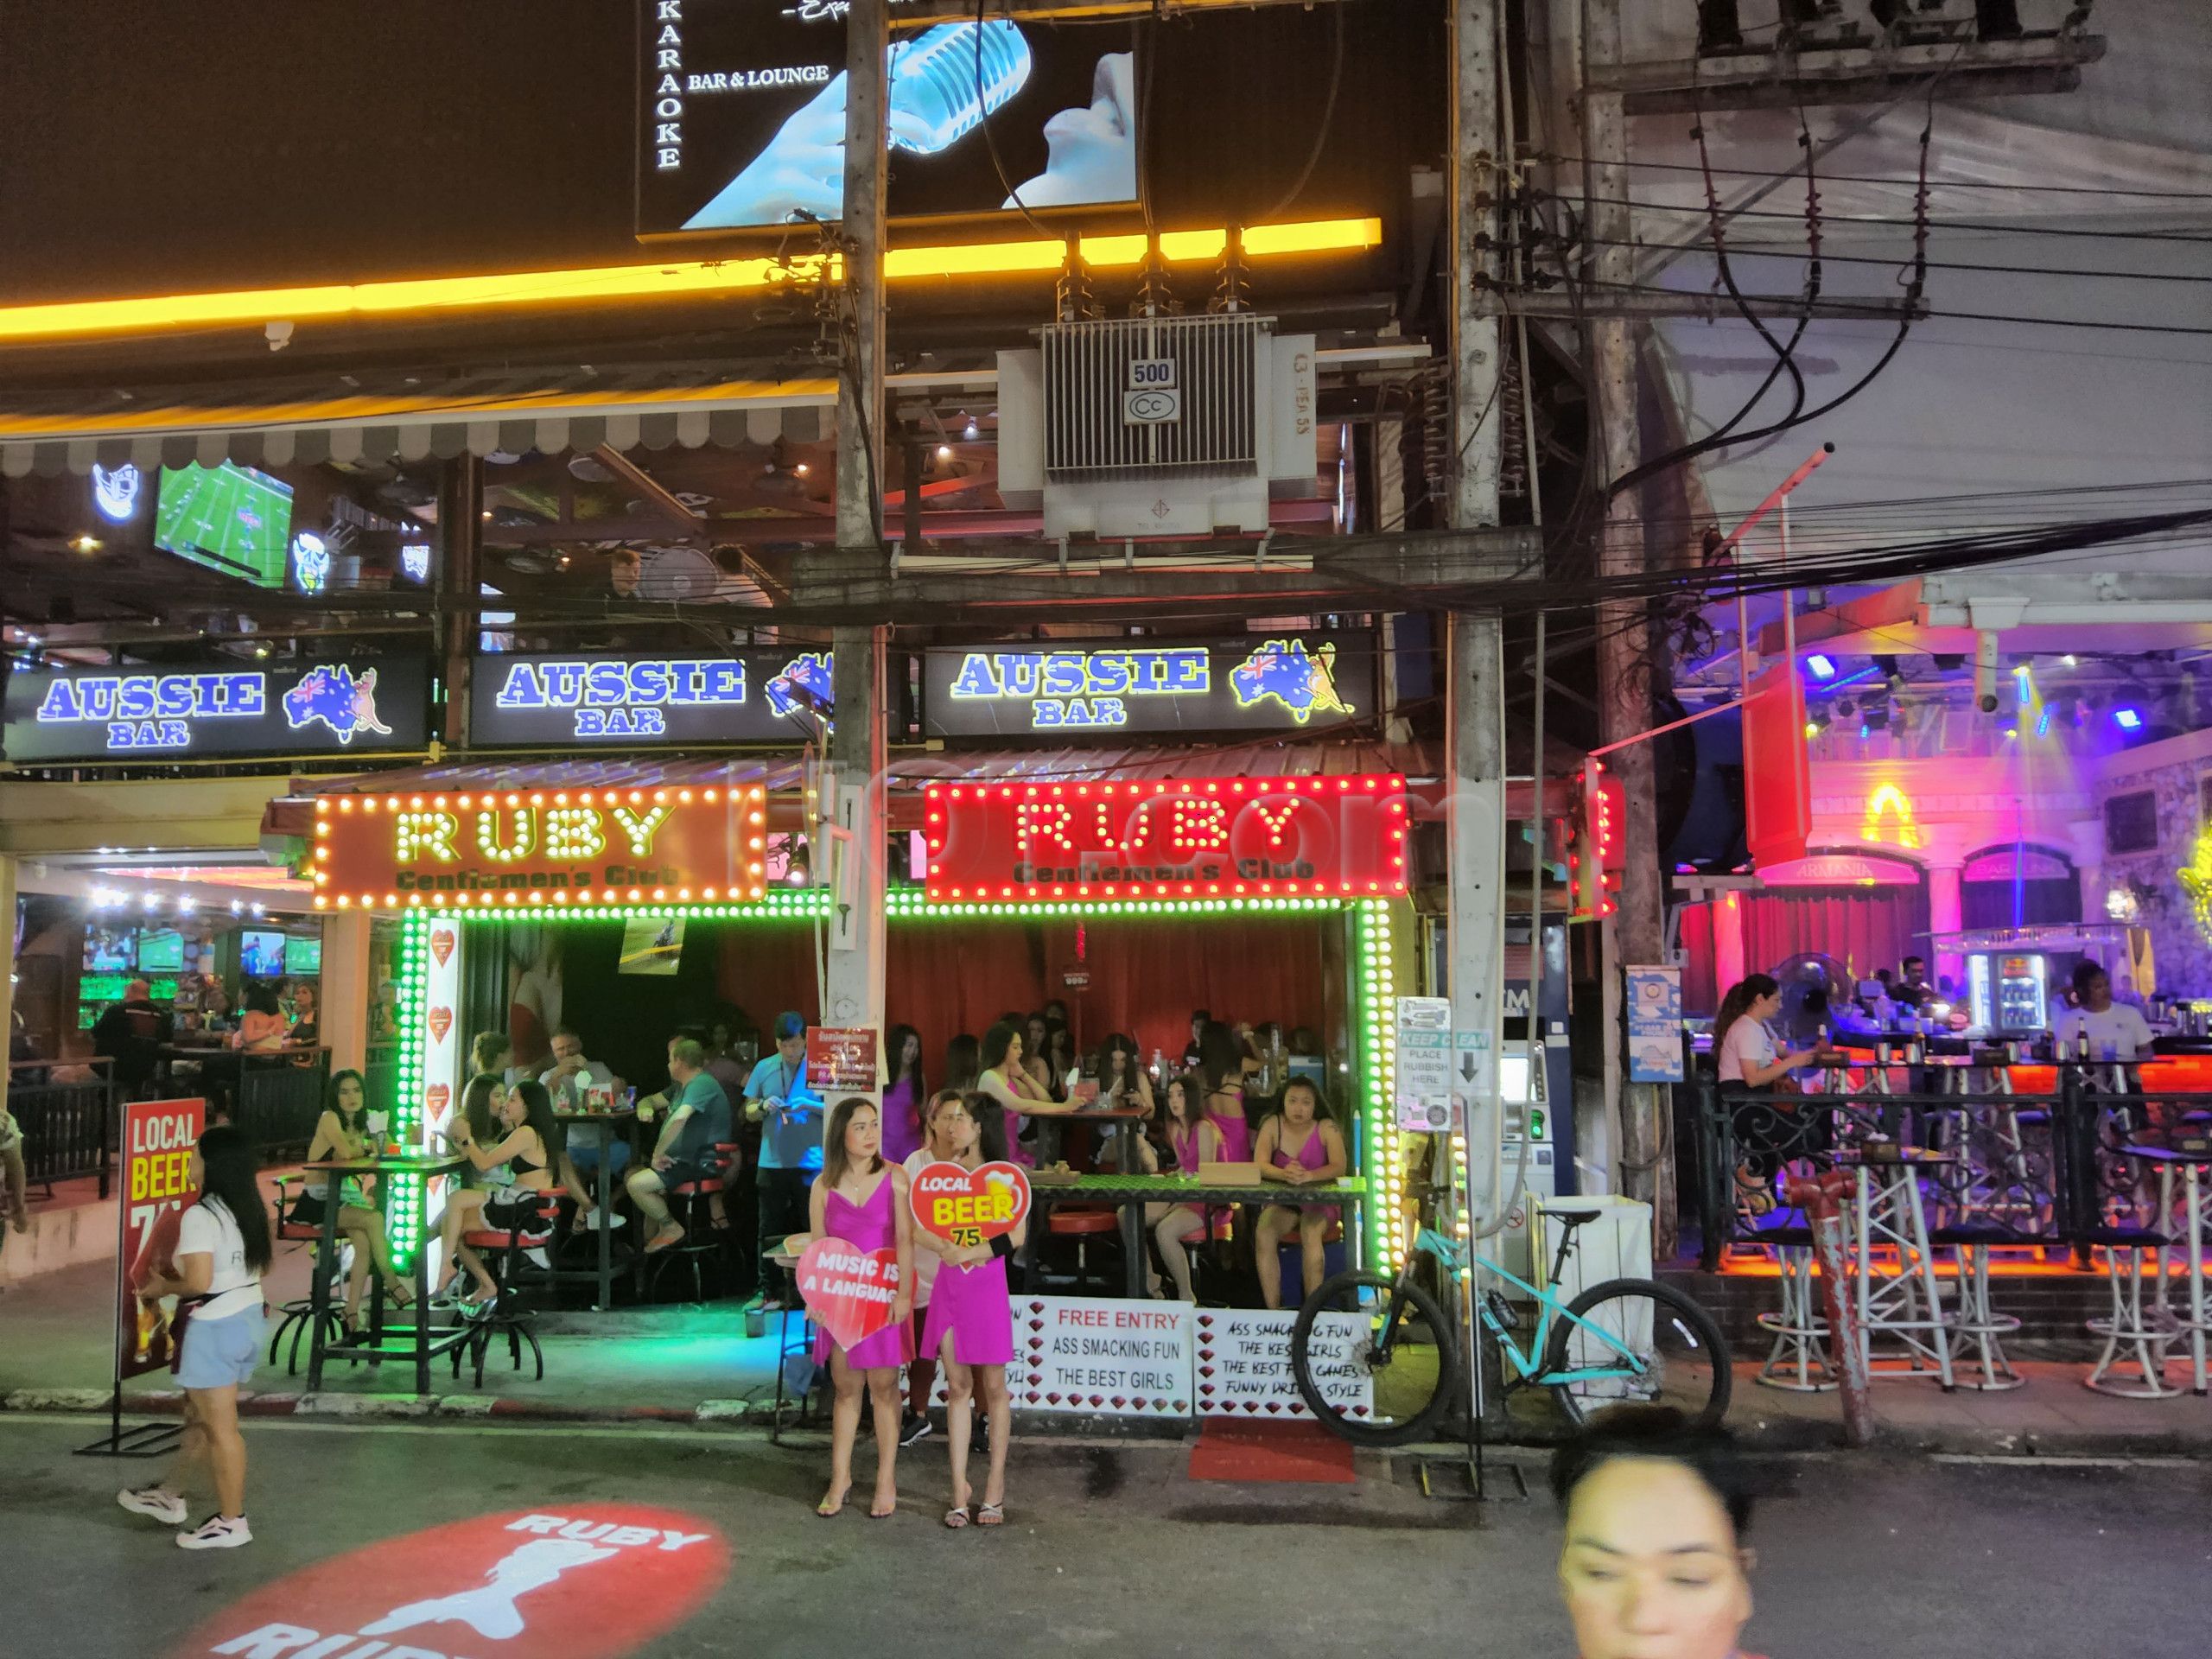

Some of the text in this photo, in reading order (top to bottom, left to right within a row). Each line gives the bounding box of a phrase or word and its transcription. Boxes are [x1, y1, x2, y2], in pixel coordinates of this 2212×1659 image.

[658, 0, 682, 168] KARAOKE
[688, 66, 830, 90] BAR & LOUNGE
[1135, 363, 1169, 383] 500
[497, 658, 746, 708] AUSSIE
[950, 647, 1210, 698] AUSSIE
[37, 672, 265, 722] AUSSIE
[574, 707, 665, 737] BAR
[1032, 697, 1128, 727] BAR
[107, 721, 191, 749] BAR
[395, 804, 677, 861] RUBY
[1011, 798, 1302, 851] RUBY
[605, 864, 679, 887] Club
[1237, 858, 1315, 880] Club
[1401, 1033, 1487, 1048] KEEP CEAN
[1409, 1050, 1441, 1059] PLACE
[1403, 1062, 1448, 1072] RUBBISH
[1412, 1075, 1440, 1084] HERE
[133, 1113, 197, 1153] LOCAL
[920, 1177, 973, 1192] LOCAL
[933, 1193, 1015, 1226] BEER
[816, 1250, 899, 1282] MUSIC IS
[803, 1274, 898, 1303] A LANGUAG
[1058, 1309, 1180, 1330] FREE ENTRY
[1227, 1321, 1250, 1336] ASS
[1327, 1325, 1353, 1338] FUN
[1052, 1337, 1180, 1360] ASS SMACKING FUN
[1238, 1340, 1263, 1356] THE
[1268, 1343, 1293, 1357] BES
[1056, 1367, 1174, 1390] THE BEST GIRLS
[1223, 1360, 1248, 1374] THE
[1253, 1362, 1282, 1376] BEST
[1316, 1364, 1358, 1378] GAMES
[1225, 1381, 1267, 1396] FUNNY
[1326, 1383, 1363, 1398] STYLE
[505, 1514, 711, 1551] RUBY
